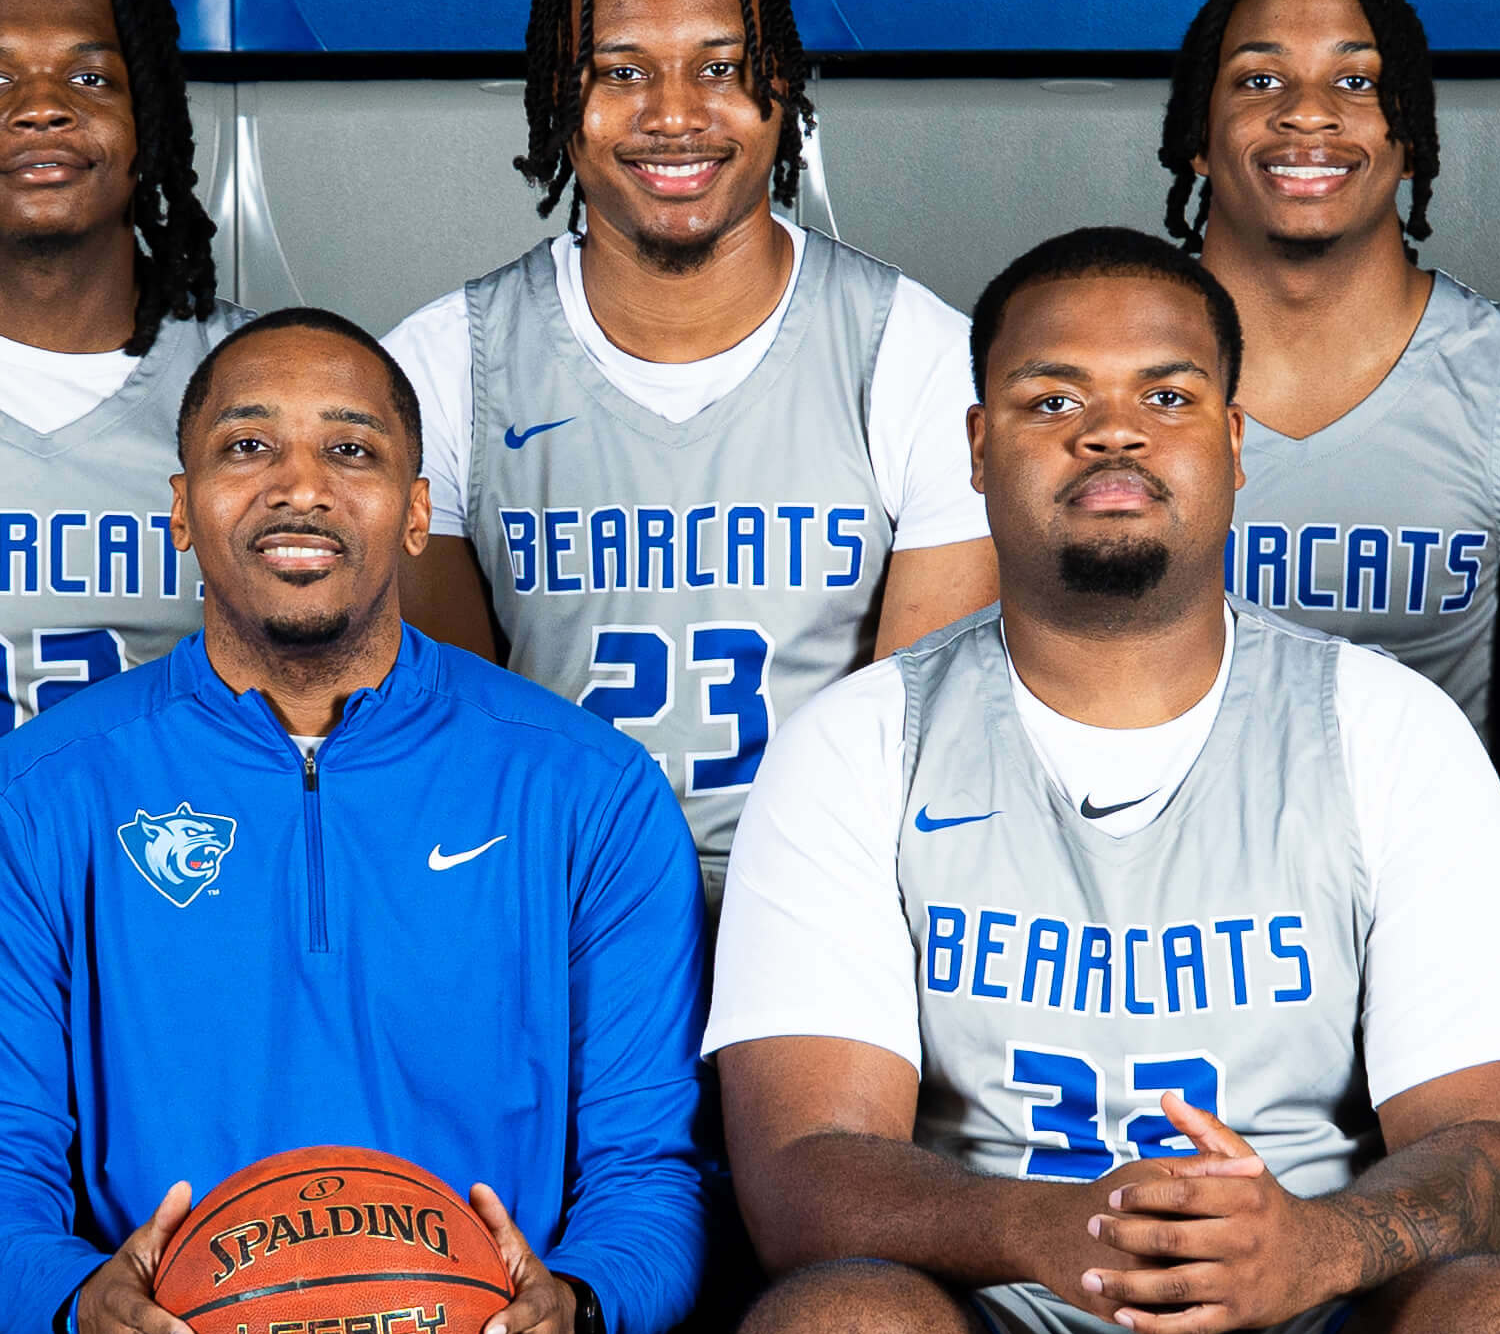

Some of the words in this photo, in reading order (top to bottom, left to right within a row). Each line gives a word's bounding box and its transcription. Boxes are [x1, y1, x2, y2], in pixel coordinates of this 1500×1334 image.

[498, 502, 871, 595] BEARCATS
[1224, 522, 1489, 615] RCATS
[576, 621, 776, 797] 23
[922, 901, 1317, 1019] BEARCATS
[1004, 1040, 1228, 1184] 32
[209, 1202, 450, 1287] SPALDING
